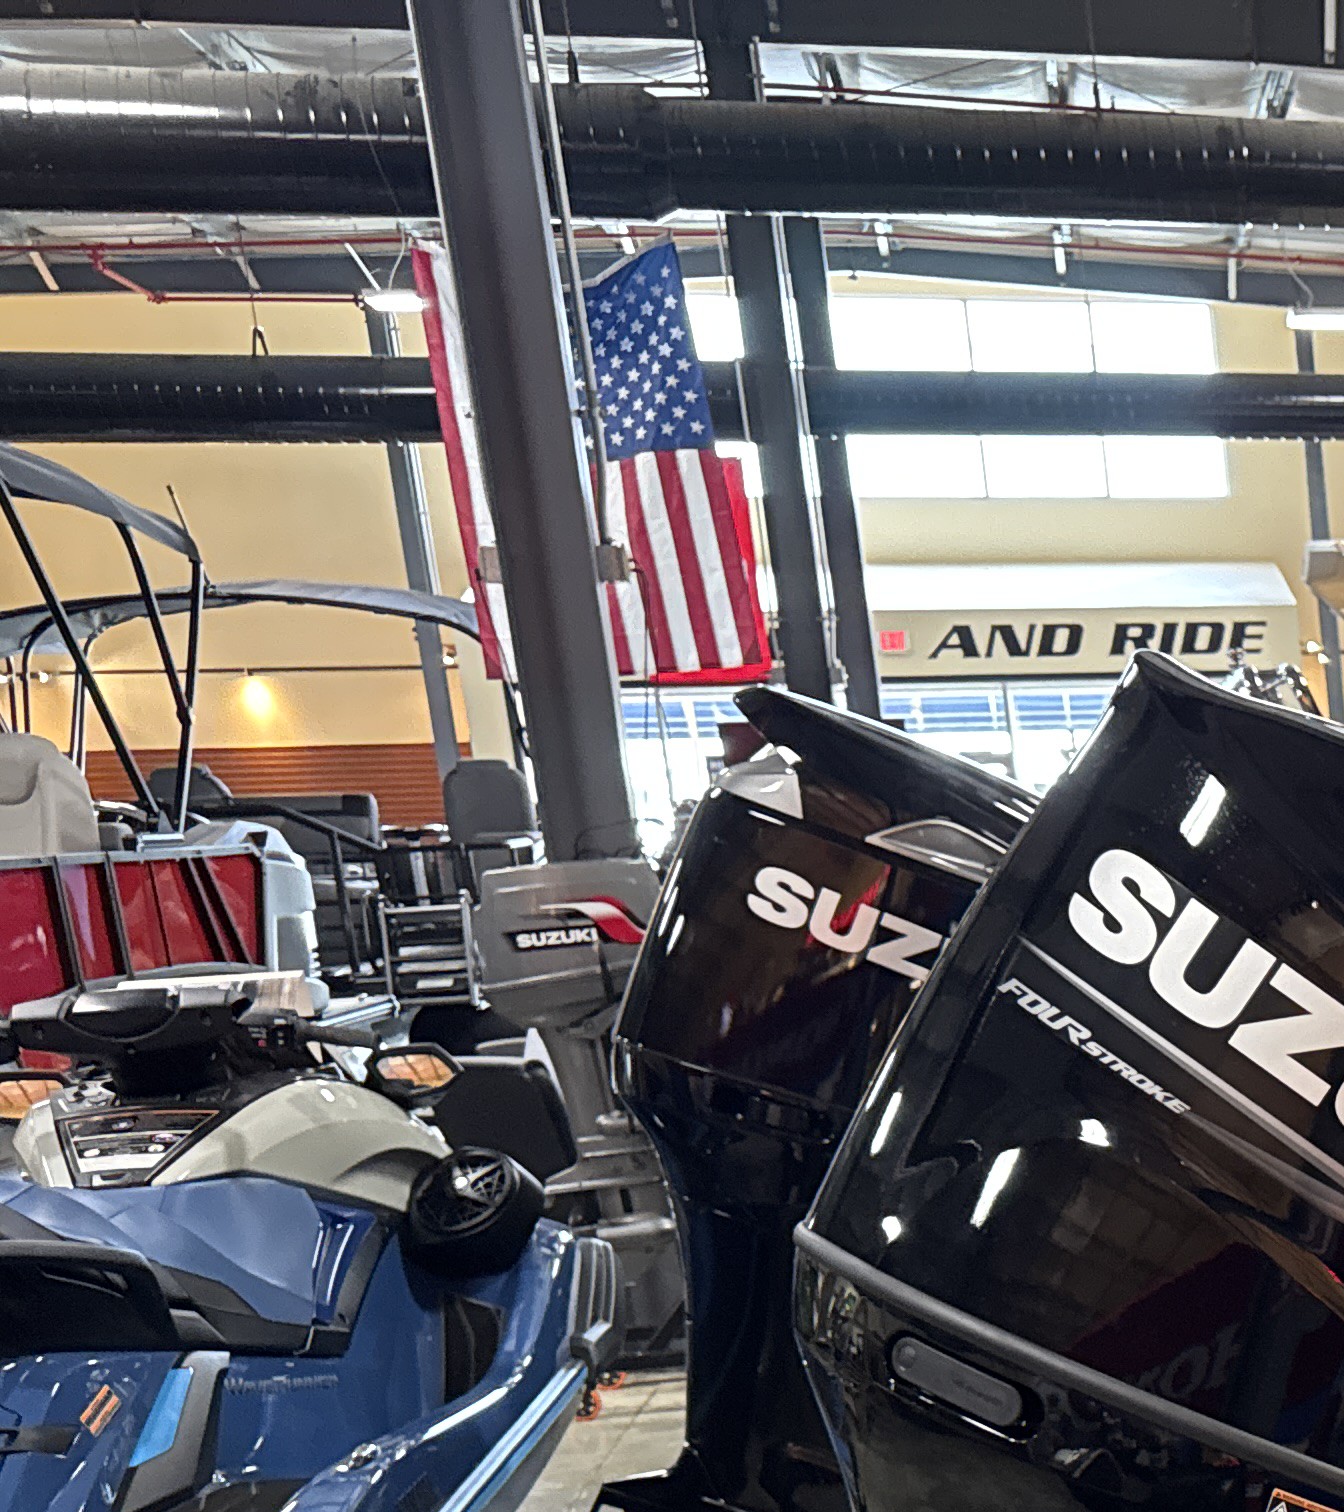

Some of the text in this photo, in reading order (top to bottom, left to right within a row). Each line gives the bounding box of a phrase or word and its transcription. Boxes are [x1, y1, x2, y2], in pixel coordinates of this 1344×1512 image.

[929, 622, 1084, 659] AND
[1109, 620, 1267, 656] RIDE
[515, 926, 599, 949] SUZUKI
[746, 866, 951, 983] SUZ
